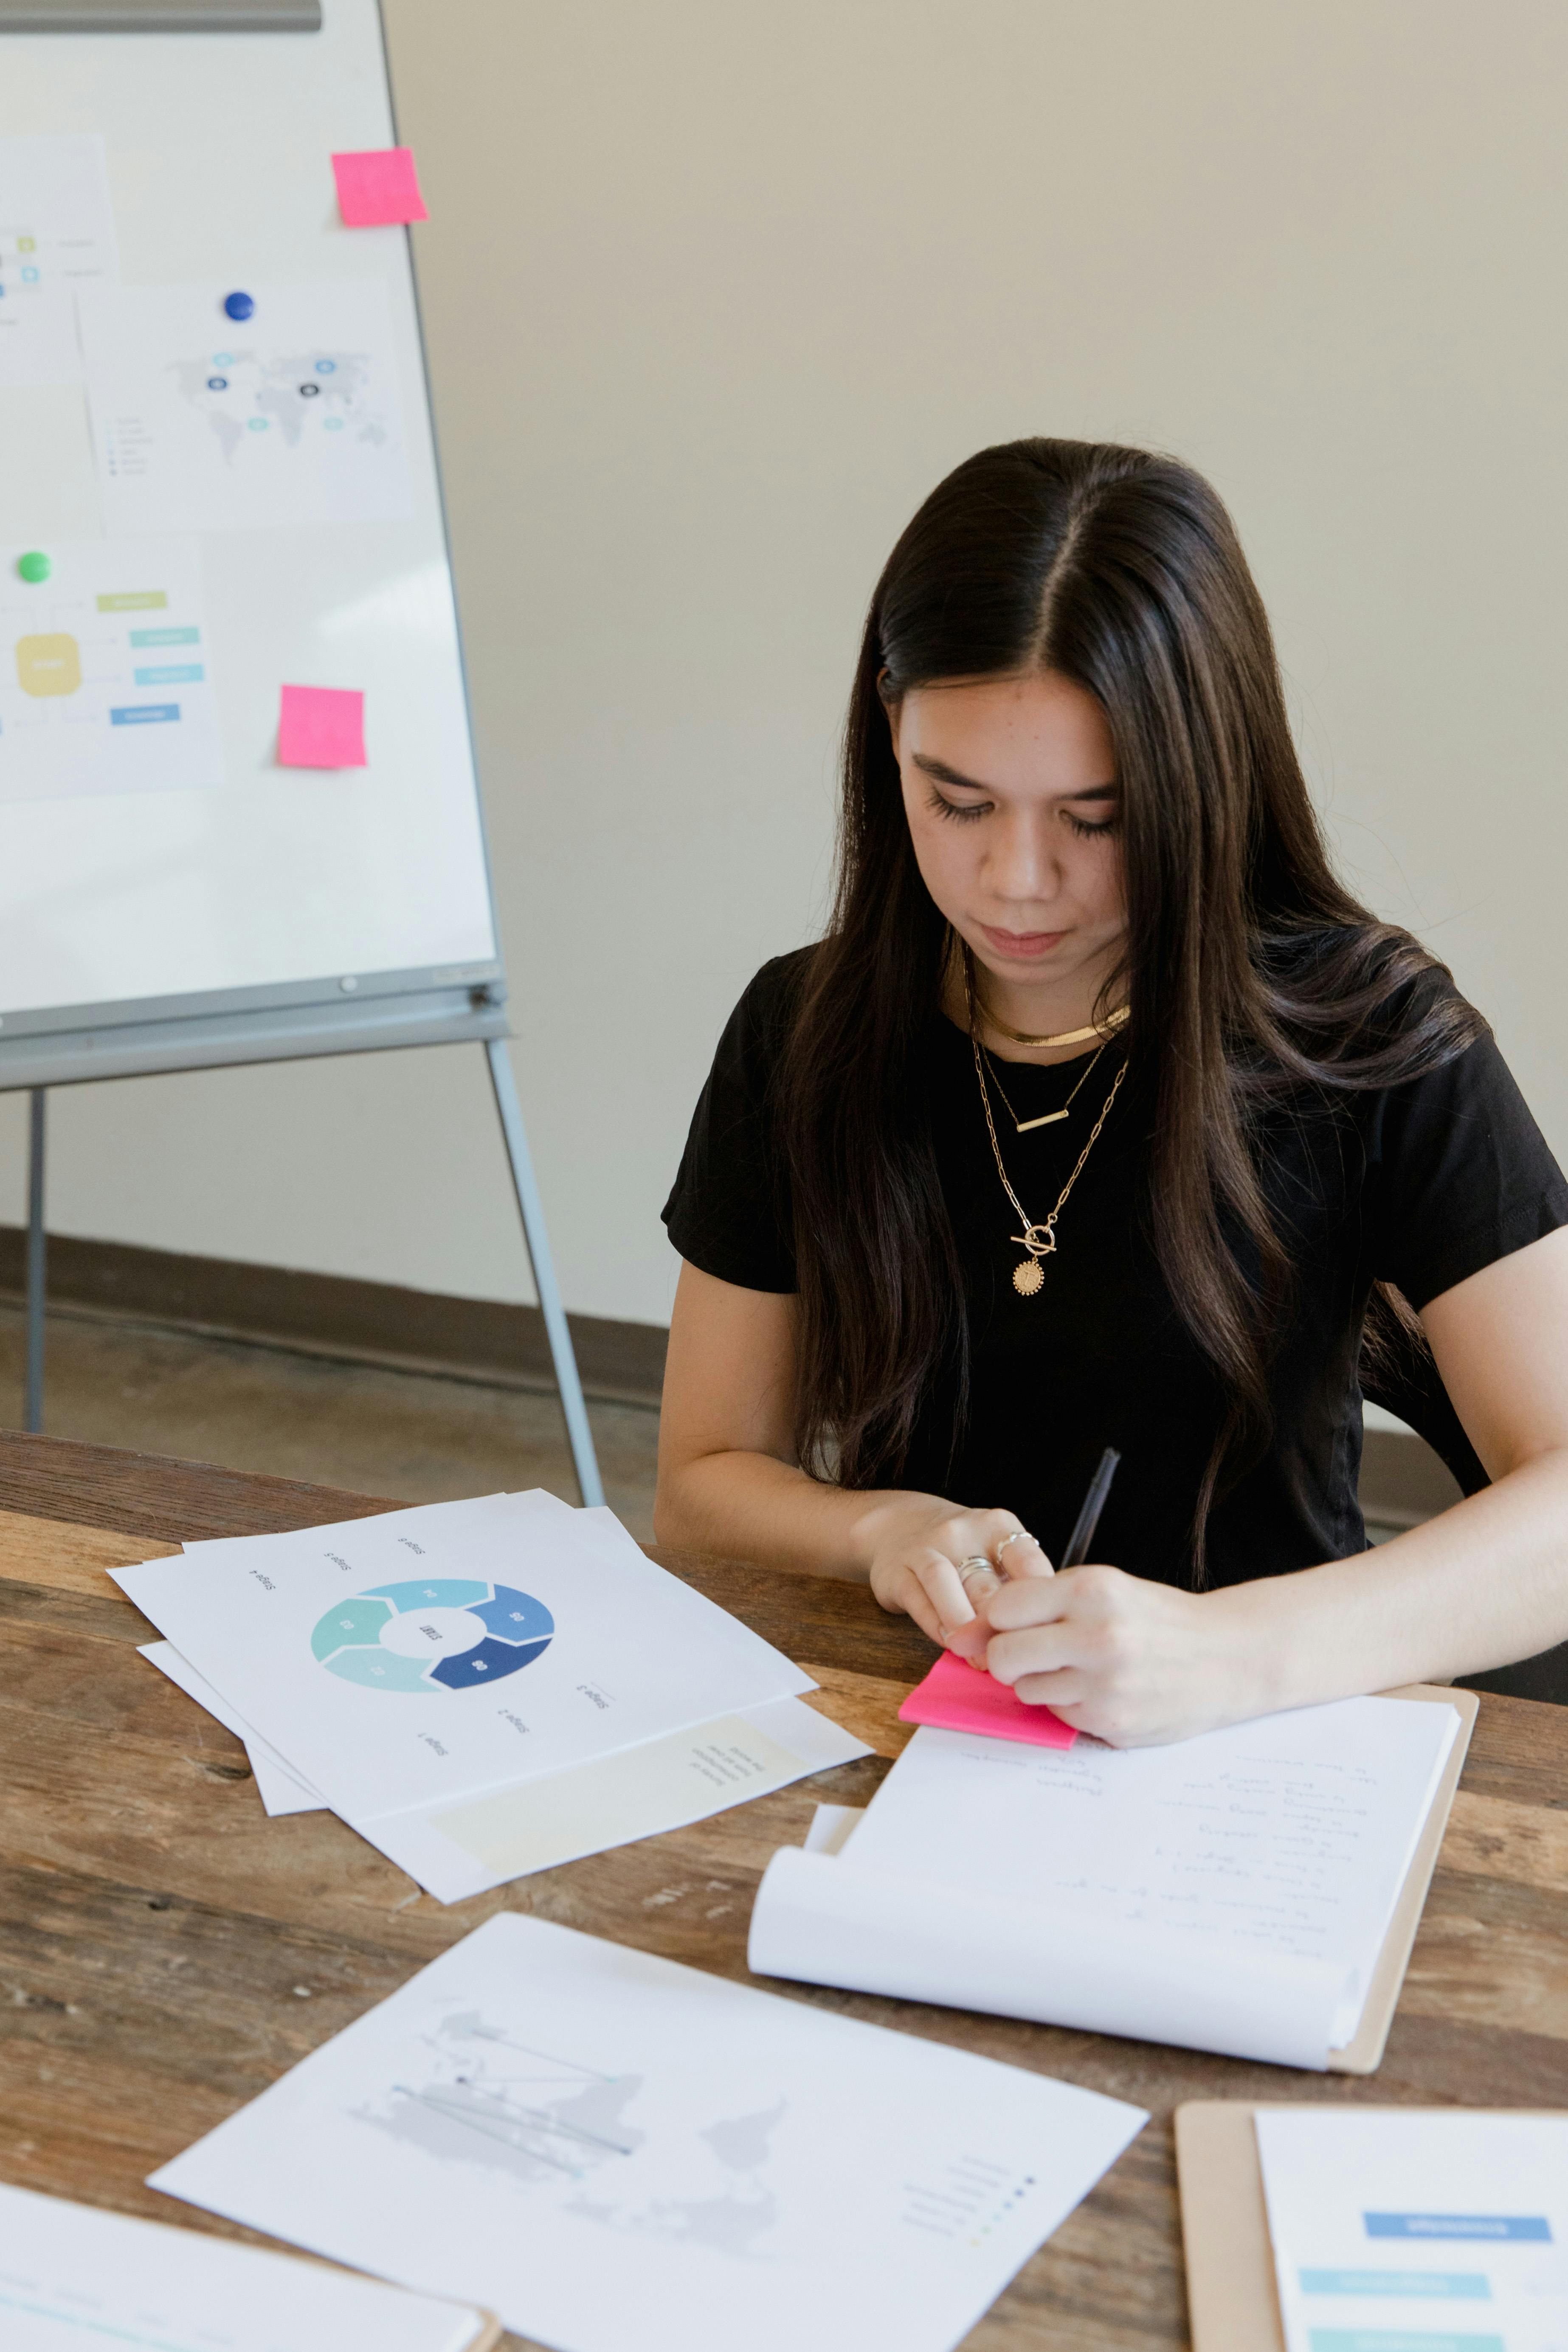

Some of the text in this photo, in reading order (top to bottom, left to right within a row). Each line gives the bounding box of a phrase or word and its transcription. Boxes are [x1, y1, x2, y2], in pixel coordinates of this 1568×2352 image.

[404, 1541, 426, 1555] Stage
[330, 1557, 352, 1571] Stage
[255, 1574, 276, 1590] Stage
[423, 1589, 437, 1598] 04
[509, 1612, 525, 1622] 05
[339, 1620, 355, 1630] 03
[419, 1625, 443, 1641] START
[471, 1660, 488, 1671] 06
[584, 1690, 609, 1710] Stage
[505, 1714, 530, 1734] Stage
[425, 1737, 449, 1756] Stage
